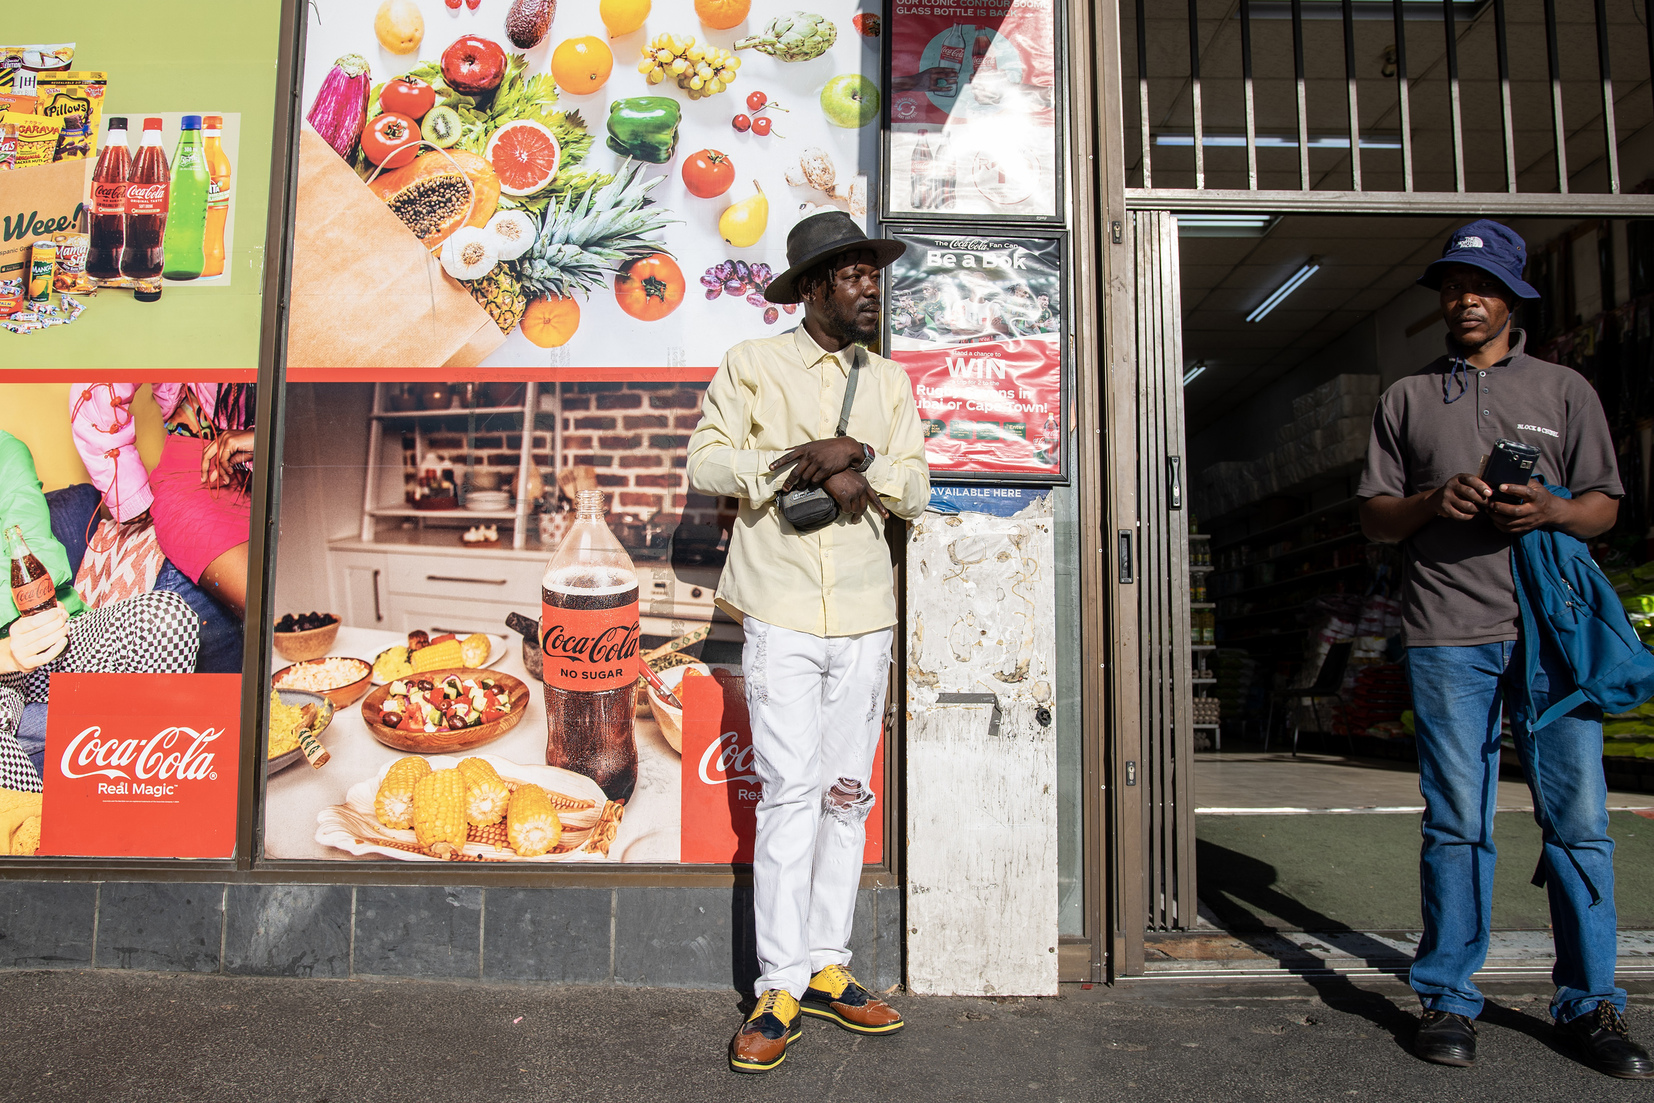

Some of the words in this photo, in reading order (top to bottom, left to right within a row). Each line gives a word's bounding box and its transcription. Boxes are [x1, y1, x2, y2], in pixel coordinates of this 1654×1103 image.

[896, 7, 931, 15] GLASS
[933, 8, 975, 16] BOTTLE
[989, 9, 1018, 17] BACK
[49, 103, 87, 118] Pillows
[127, 184, 167, 199] Coca-Cola
[3, 202, 84, 242] Weee!
[949, 239, 989, 250] Coca-Cola
[927, 250, 957, 267] Be
[961, 254, 977, 268] a
[982, 252, 1027, 270] Bok
[945, 357, 1006, 380] WIN
[947, 400, 963, 410] or
[930, 488, 990, 497] AVAILABLE
[993, 489, 1022, 498] HERE
[542, 620, 640, 664] Coca-Cola
[560, 668, 578, 679] NO
[581, 668, 623, 680] SUGAR
[60, 725, 226, 780] Coca-Cola
[97, 782, 129, 795] Real
[132, 782, 174, 798] Magic
[738, 788, 763, 801] Rea
